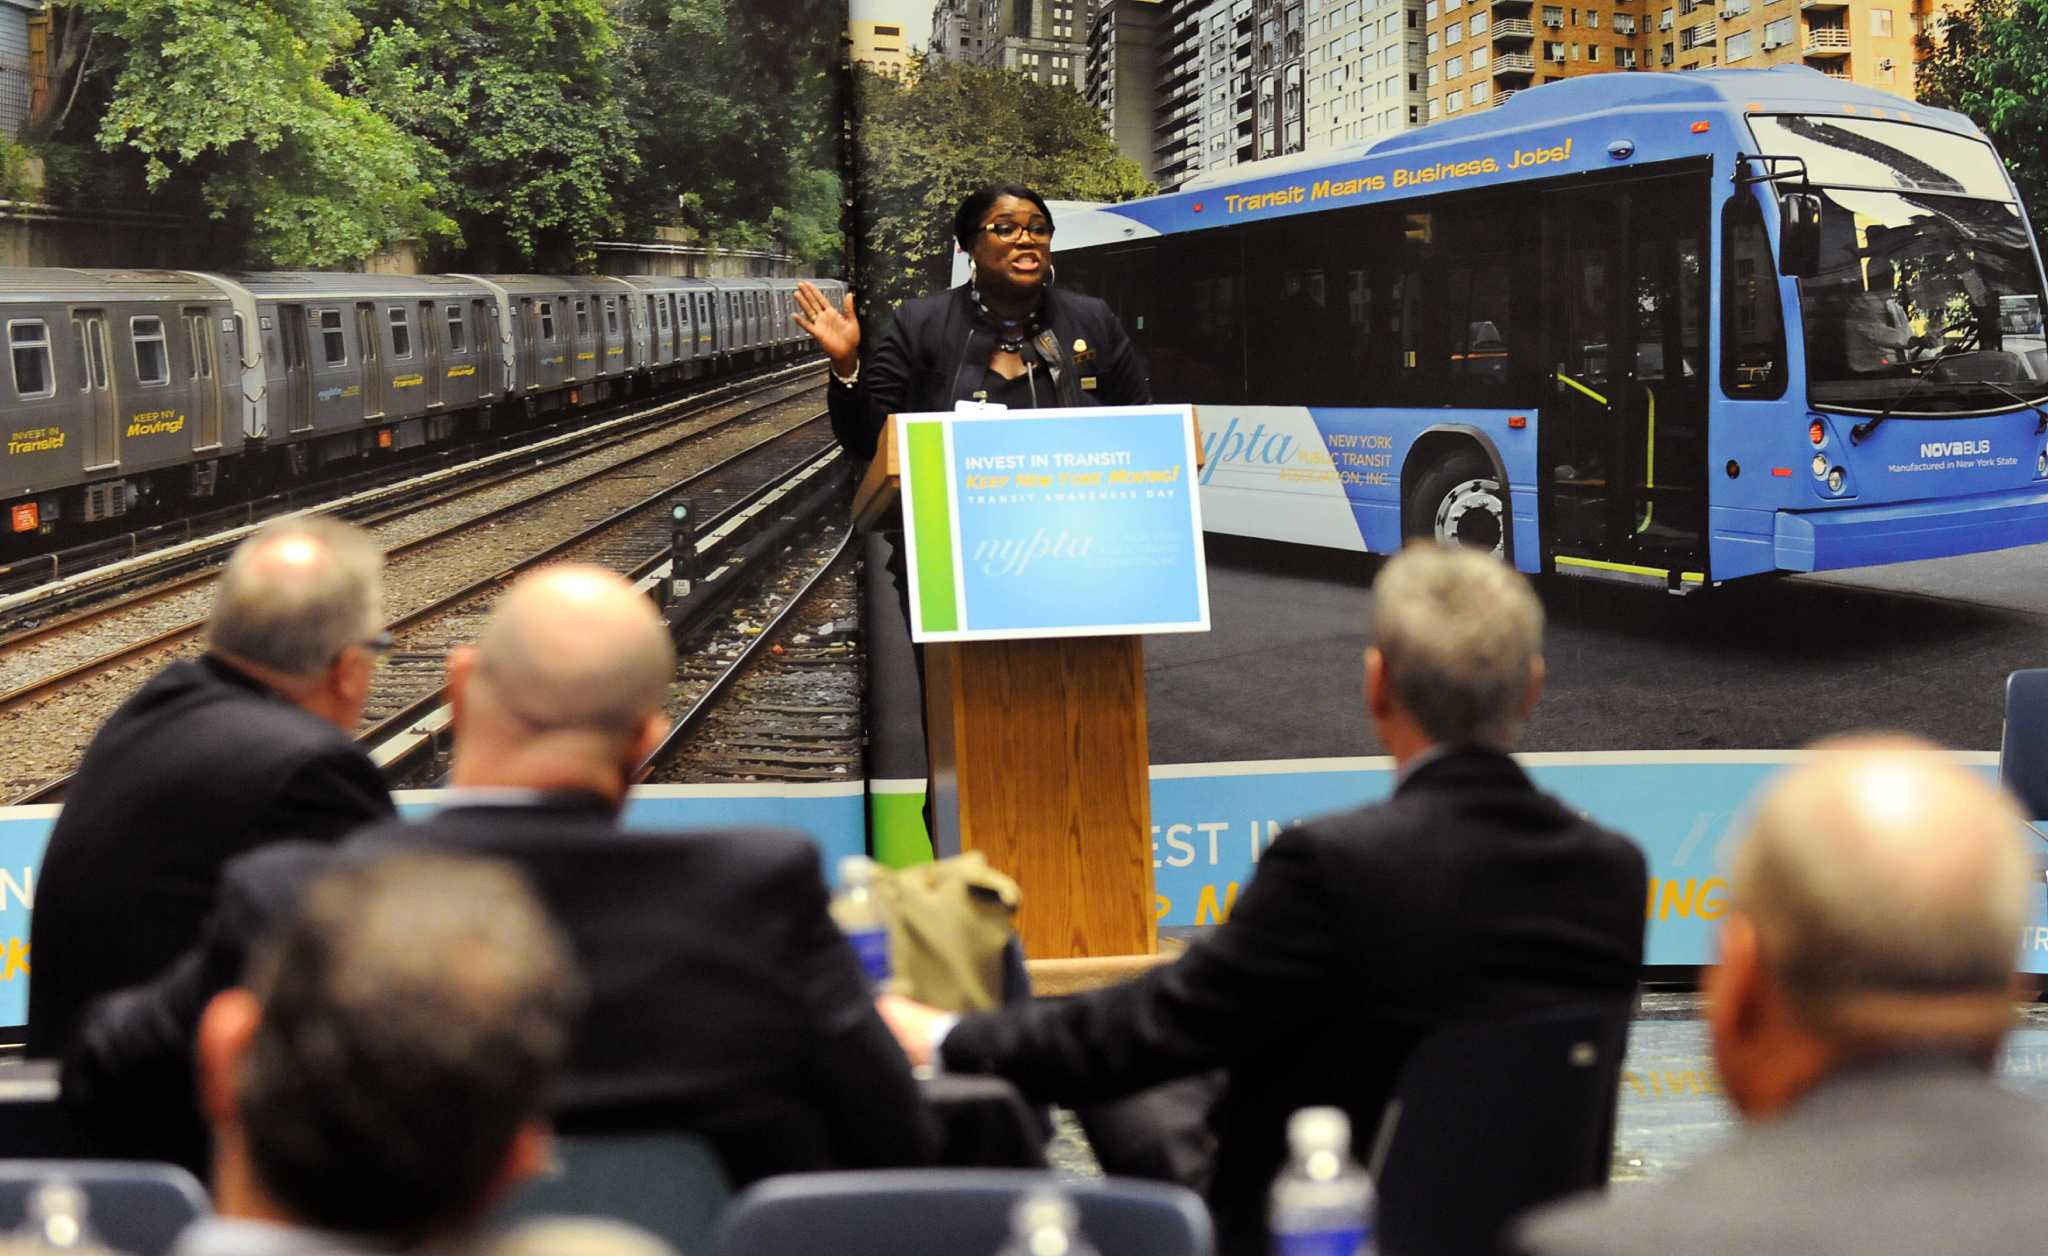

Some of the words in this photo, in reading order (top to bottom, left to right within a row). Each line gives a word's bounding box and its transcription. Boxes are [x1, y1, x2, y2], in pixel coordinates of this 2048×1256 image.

[1224, 186, 1304, 214] Transit
[1311, 174, 1386, 202] Means
[1392, 155, 1500, 188] Business,
[1506, 138, 1573, 170] Jobs!
[127, 415, 185, 438] Moving!
[133, 412, 158, 422] KEEP
[161, 410, 175, 419] NY
[8, 433, 65, 455] Transit!
[1200, 416, 1299, 486] ypta
[1328, 434, 1357, 448] NEW
[1359, 435, 1393, 449] YORK
[965, 455, 1026, 471] INVEST
[1031, 453, 1049, 468] IN
[1053, 451, 1131, 468] TRANSIT!
[1342, 452, 1393, 468] TRANSIT
[1888, 460, 1946, 473] Manufactured
[1947, 460, 1955, 470] in
[1956, 459, 1974, 469] New
[1975, 457, 1995, 468] York
[1996, 456, 2018, 467] State
[1146, 488, 1176, 499] DAY
[973, 527, 1095, 577] nypta
[1646, 875, 1730, 922] ING
